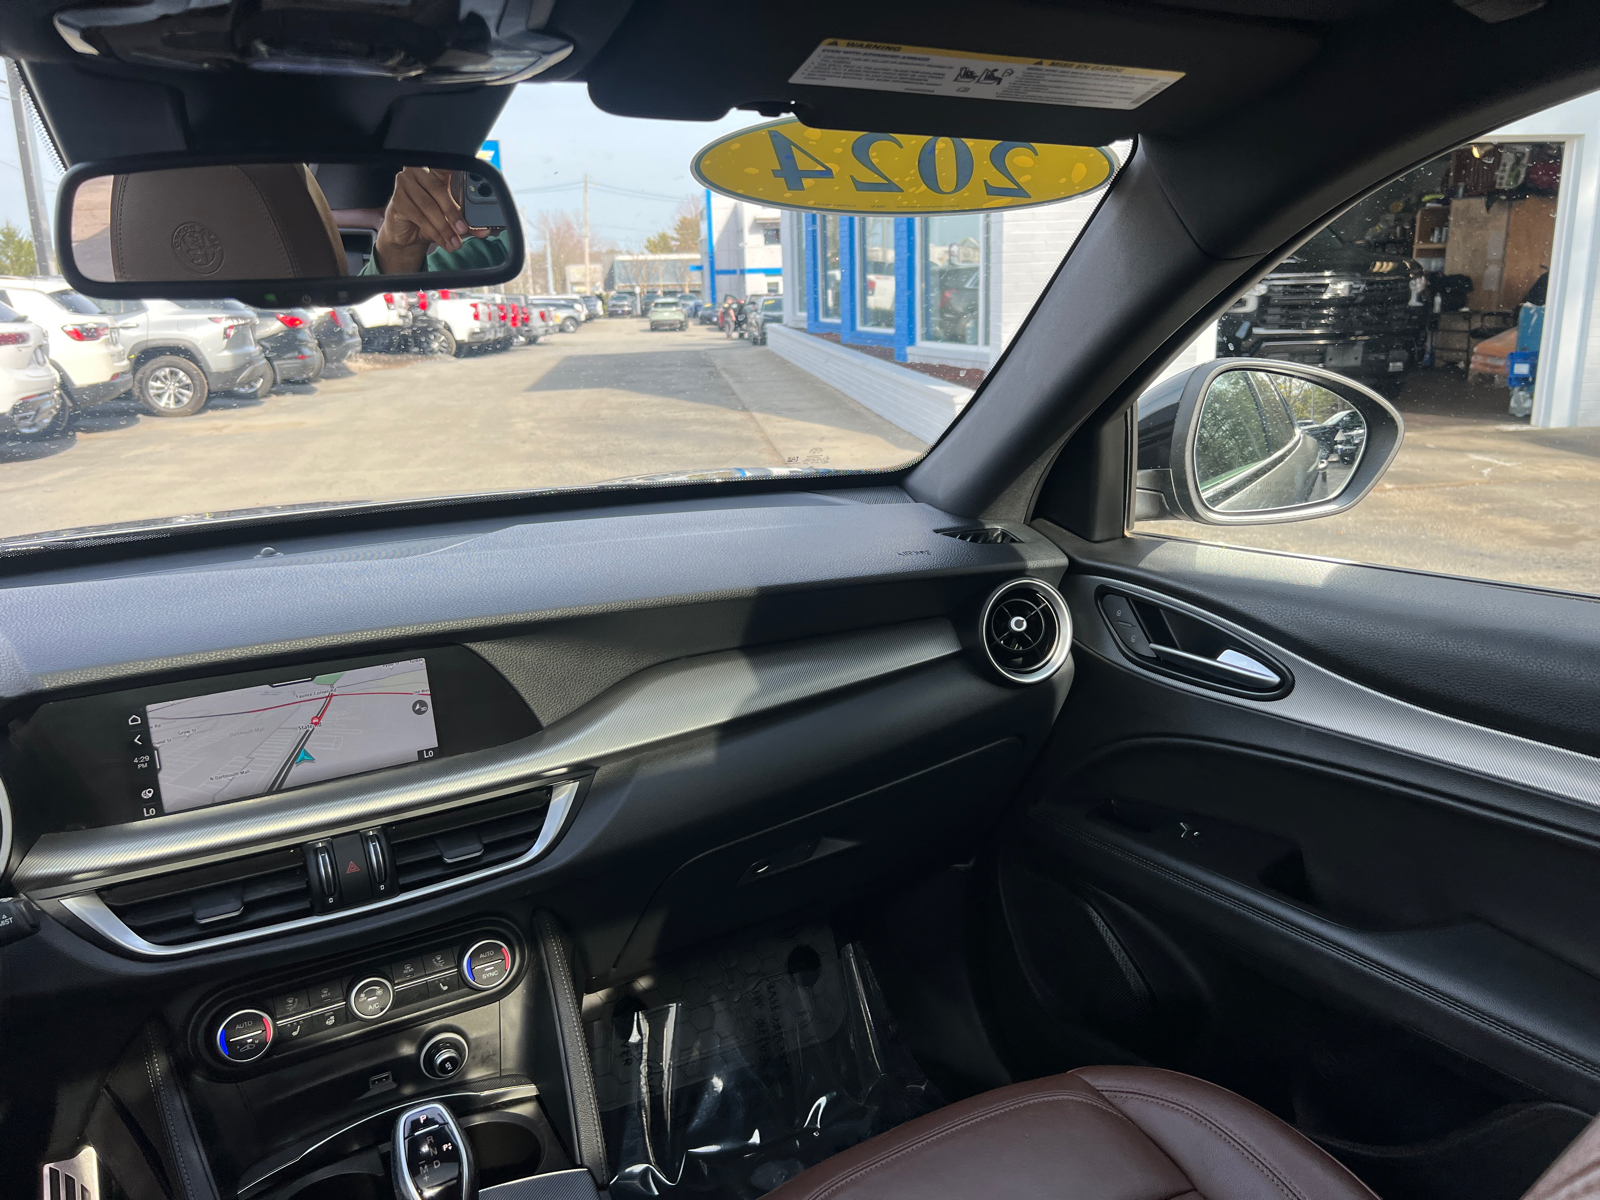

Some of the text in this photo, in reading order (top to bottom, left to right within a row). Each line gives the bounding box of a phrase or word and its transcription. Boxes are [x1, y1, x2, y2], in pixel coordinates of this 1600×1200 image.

[846, 41, 902, 52] WARNING
[1091, 65, 1125, 73] GARDE
[133, 755, 150, 764] 4:29
[215, 772, 239, 780] Dartmouth
[479, 950, 494, 959] AUTO
[482, 970, 499, 980] SYNC
[368, 1002, 380, 1011] A/C
[235, 1021, 253, 1030] AUTO
[419, 1114, 427, 1123] P
[426, 1135, 434, 1144] R
[429, 1146, 438, 1157] N
[433, 1159, 441, 1169] D
